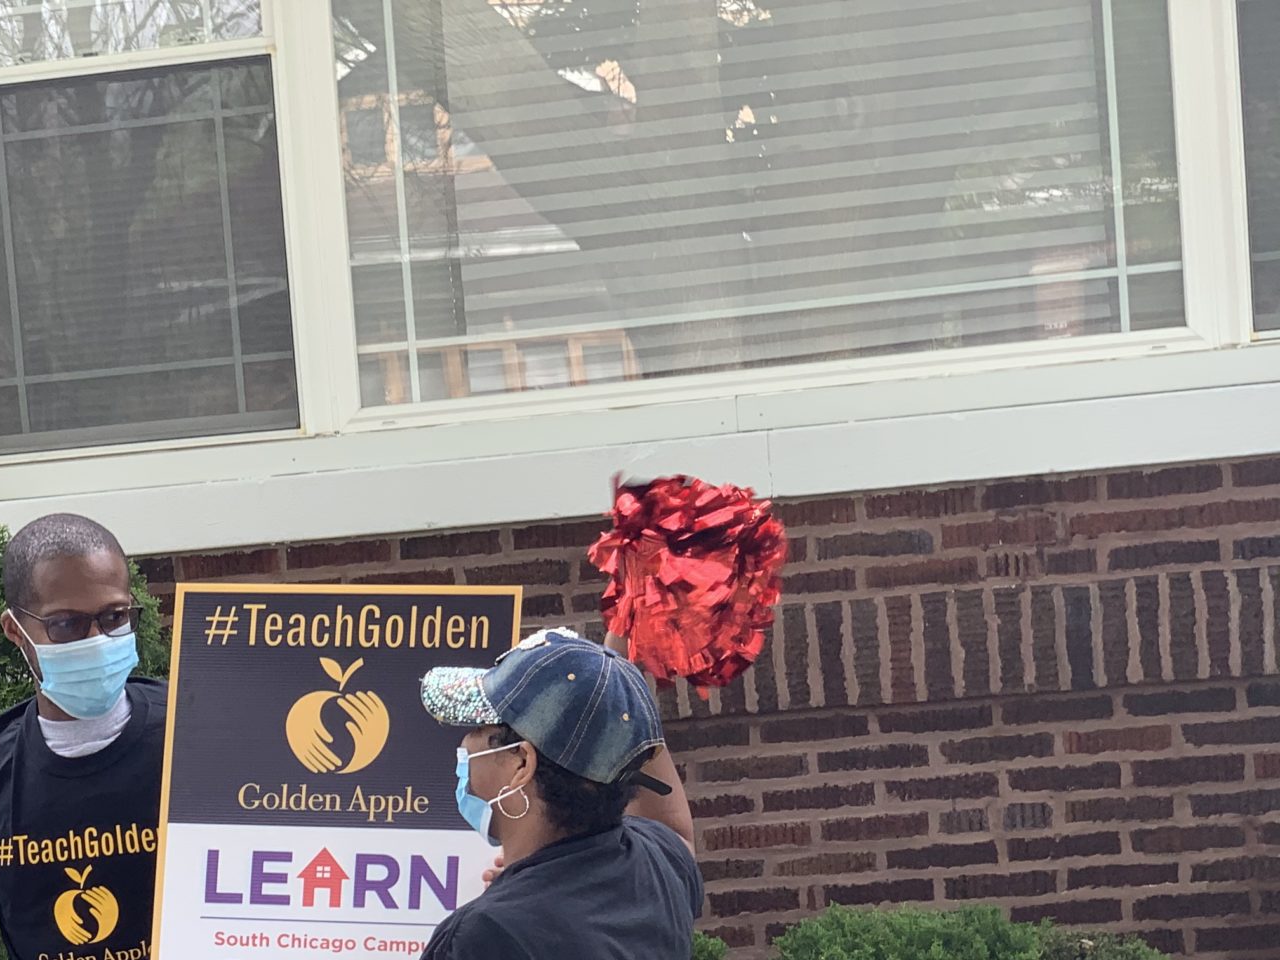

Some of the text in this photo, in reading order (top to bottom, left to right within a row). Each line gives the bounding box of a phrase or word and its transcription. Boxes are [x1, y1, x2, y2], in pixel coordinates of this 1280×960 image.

[204, 603, 490, 649] #TeachGolden
[237, 783, 429, 822] Golden Apple
[204, 847, 460, 910] LEARN
[214, 931, 426, 955] South Chicago Camp
